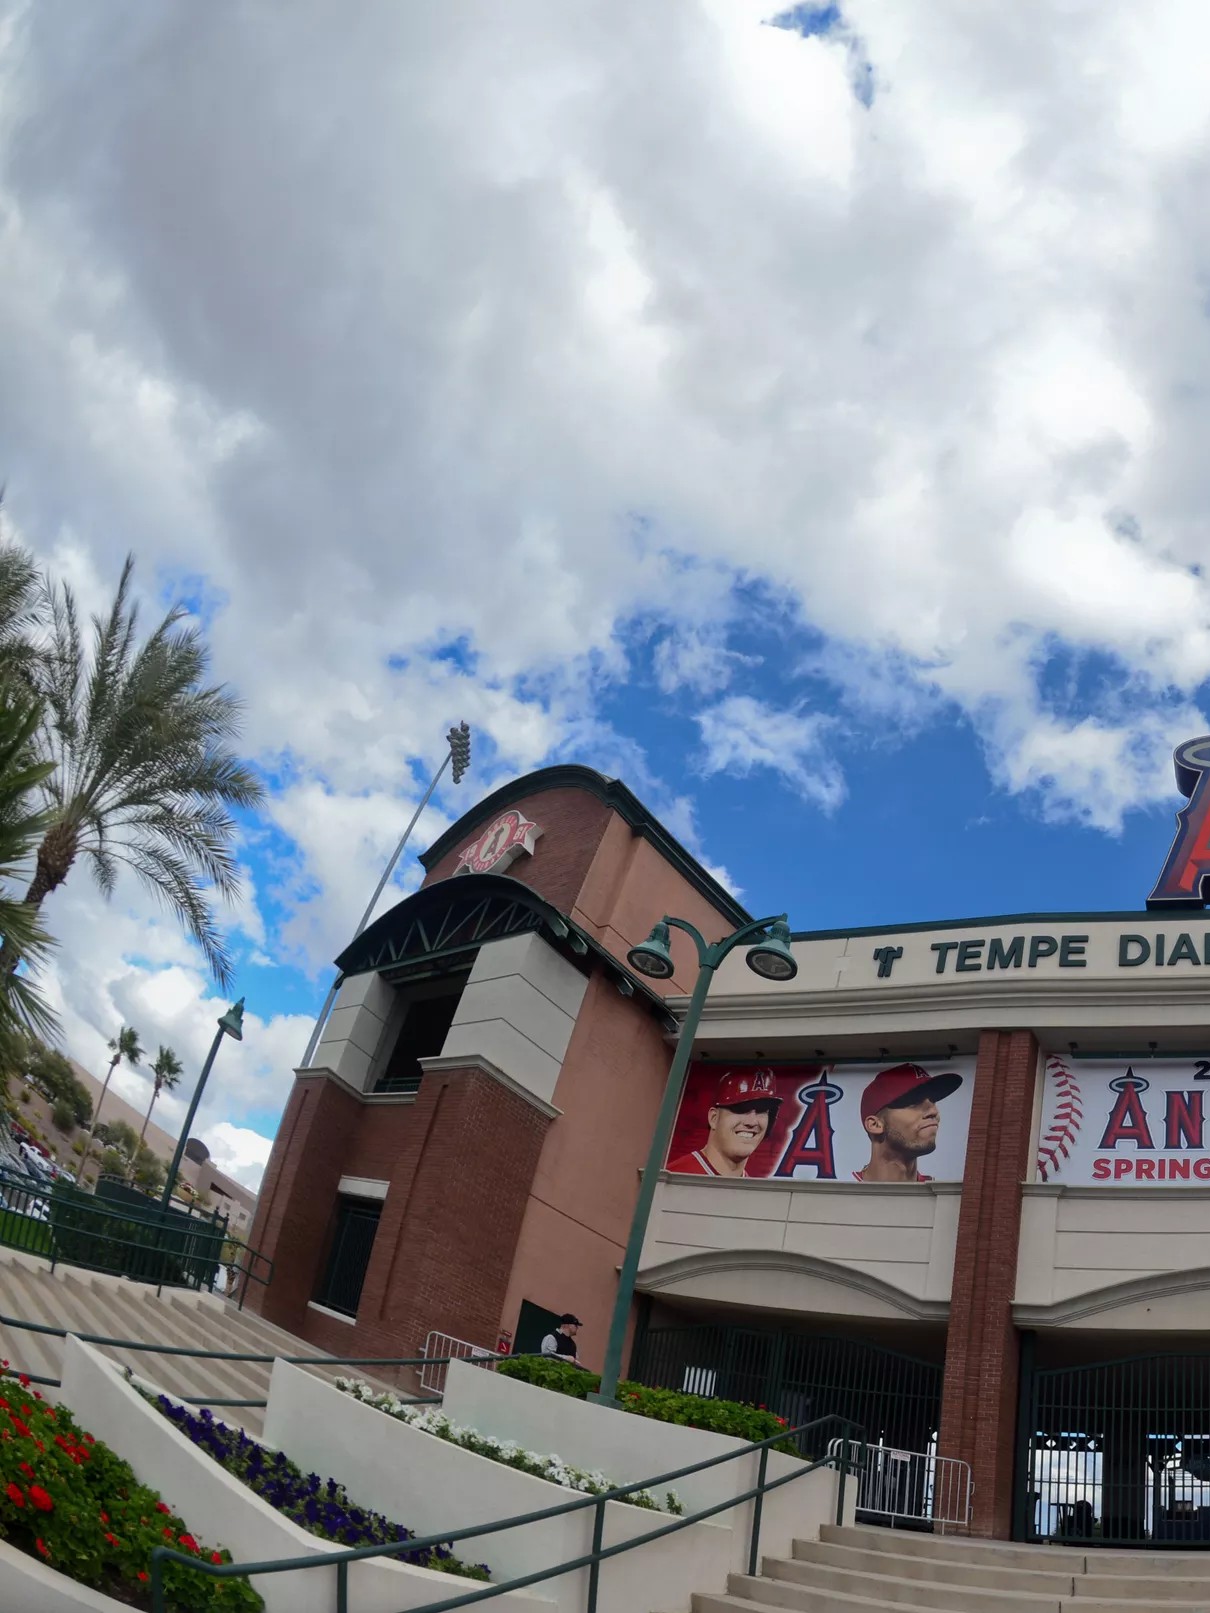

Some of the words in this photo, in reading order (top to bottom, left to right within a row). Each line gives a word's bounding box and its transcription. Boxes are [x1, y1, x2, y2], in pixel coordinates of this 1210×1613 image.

[930, 935, 1089, 973] TEMPE
[751, 1071, 768, 1092] A
[774, 1069, 844, 1180] A
